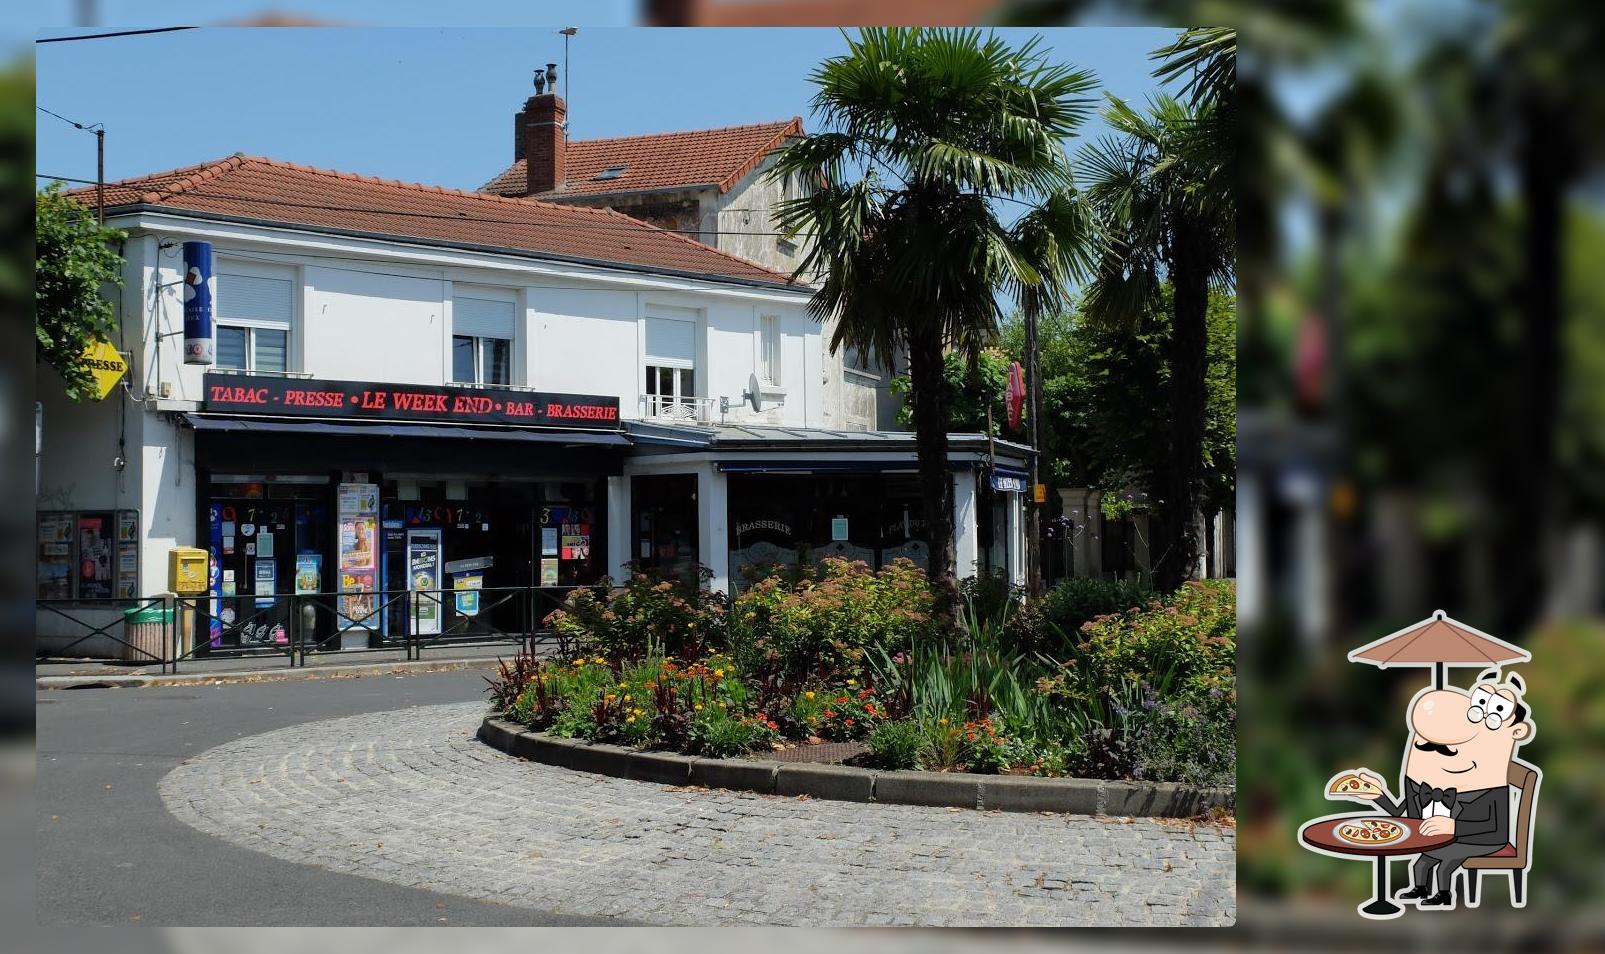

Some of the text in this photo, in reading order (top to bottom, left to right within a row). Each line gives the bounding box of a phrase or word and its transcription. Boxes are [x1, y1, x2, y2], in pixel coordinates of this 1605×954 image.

[211, 386, 617, 421] TABAC PRESSE LE WEEK END BAR BRASSERIE
[736, 520, 792, 535] BRASSERIE
